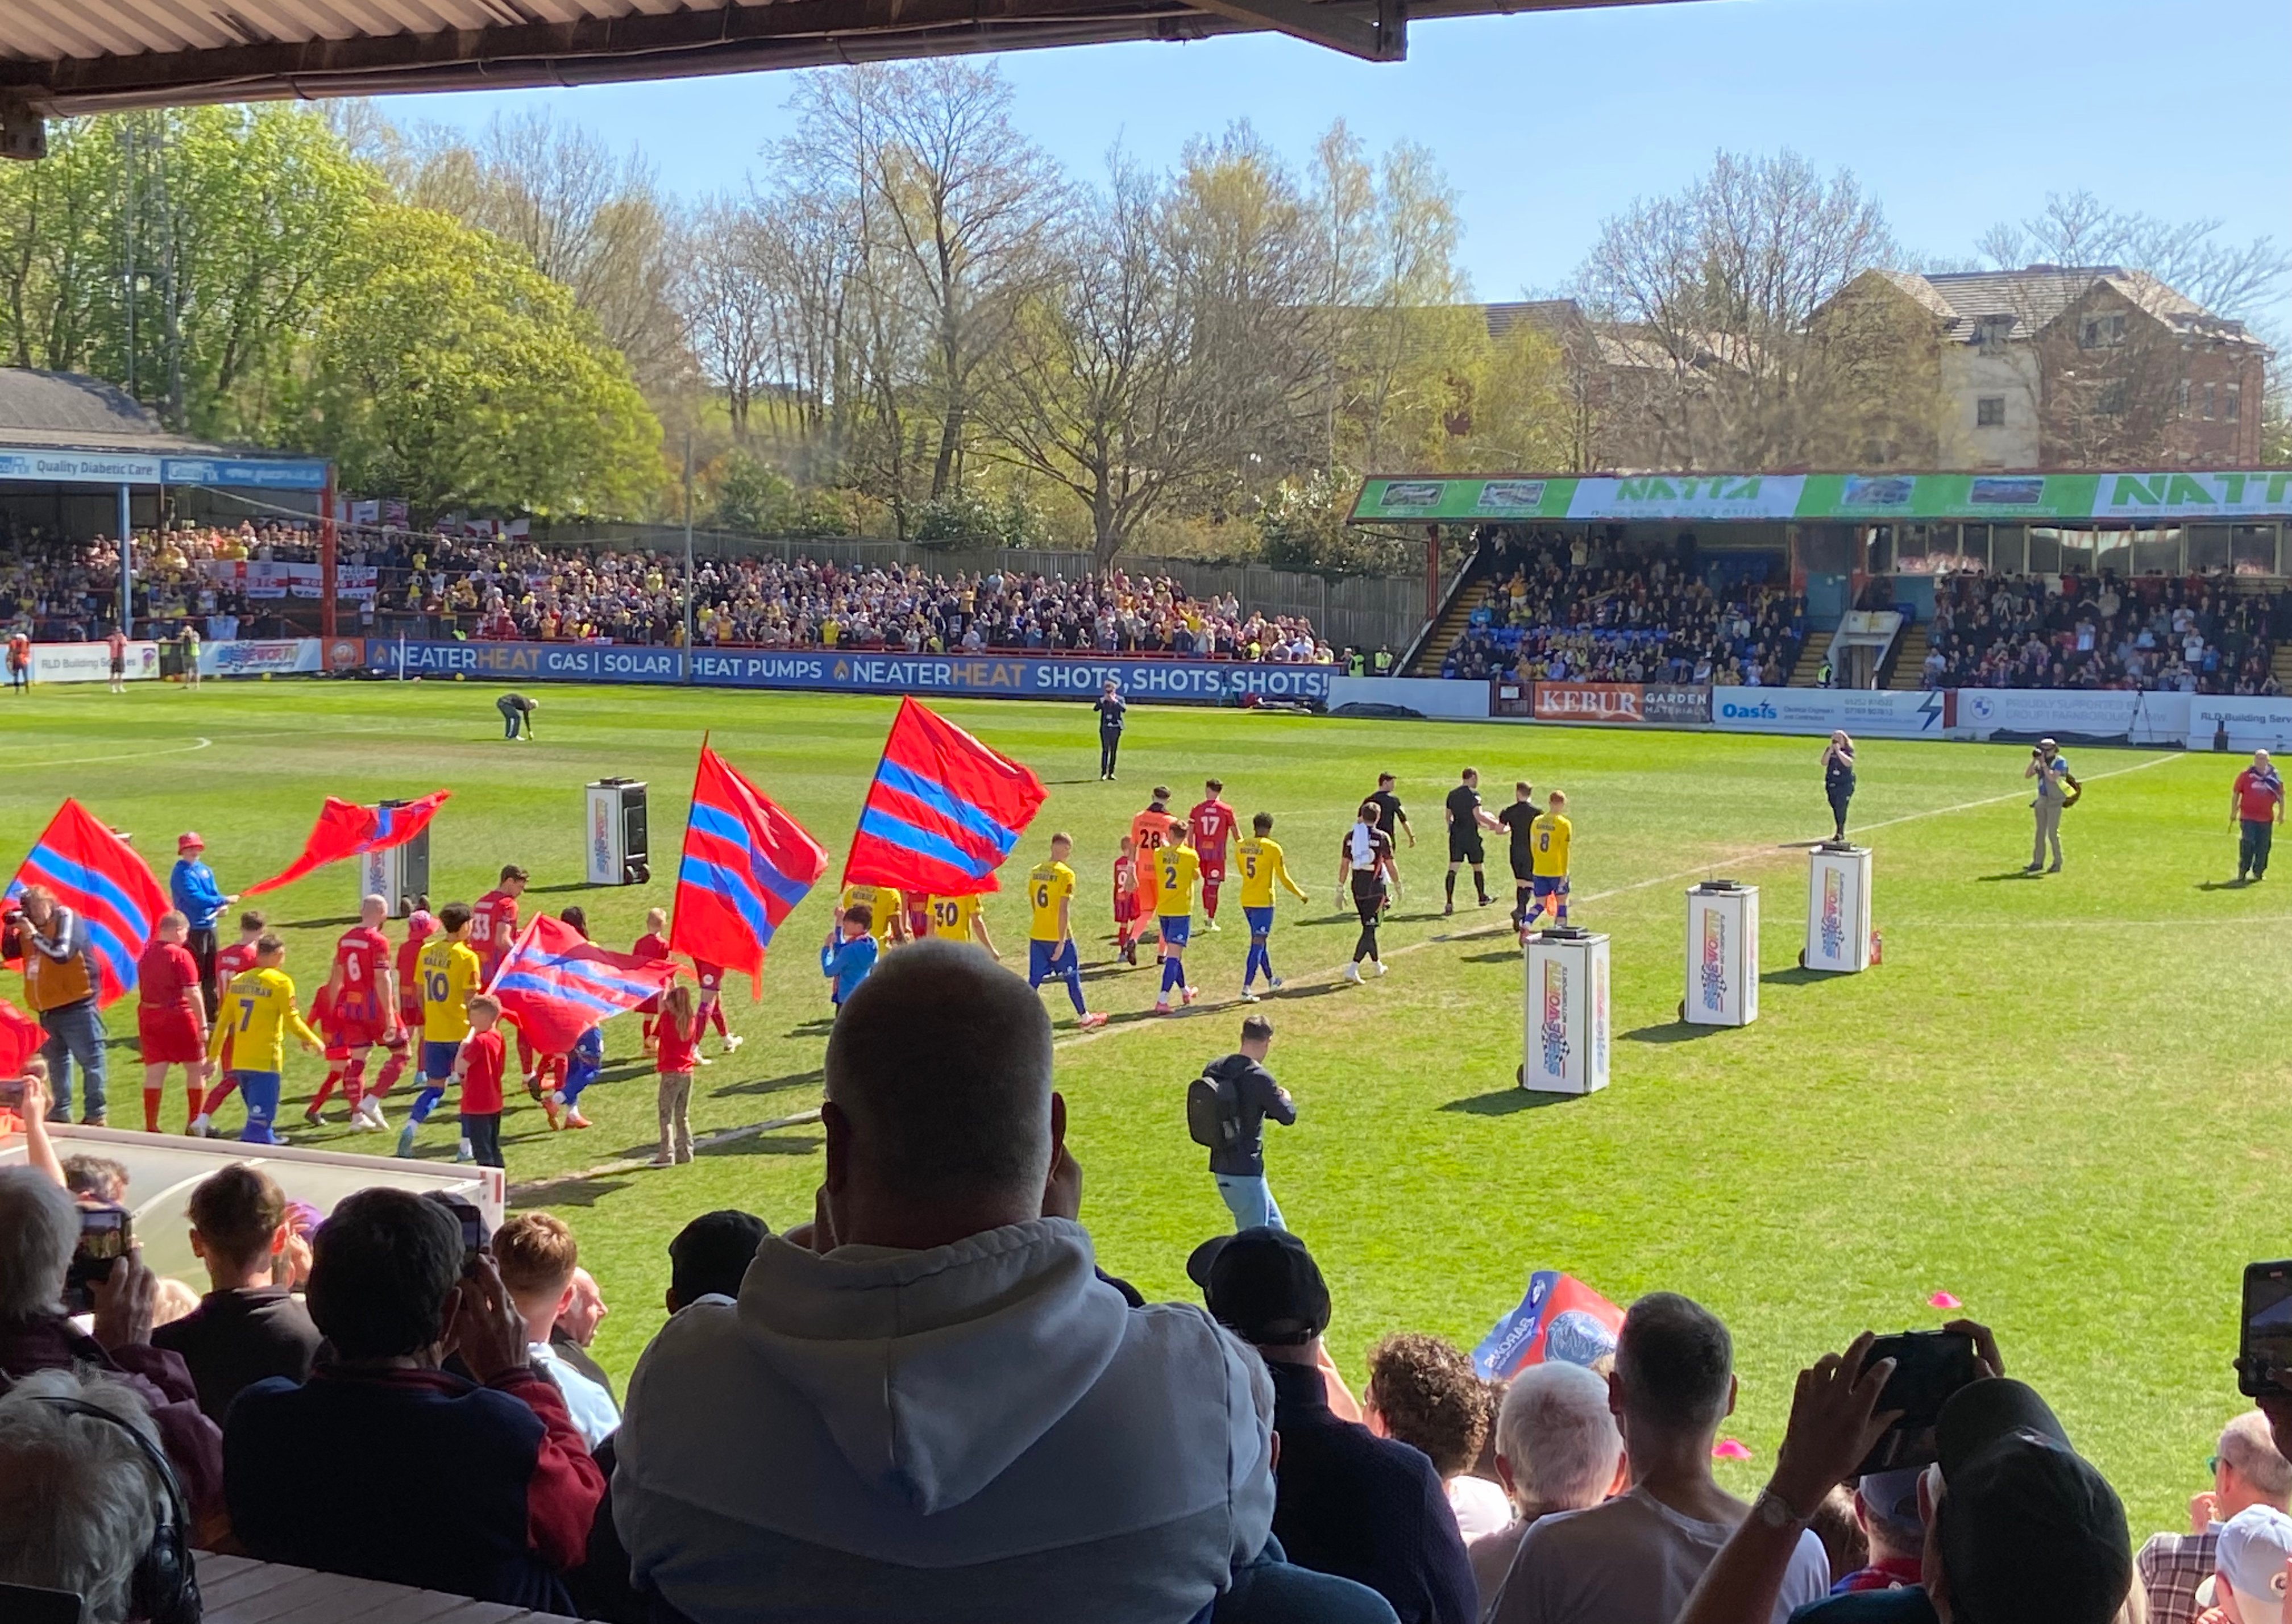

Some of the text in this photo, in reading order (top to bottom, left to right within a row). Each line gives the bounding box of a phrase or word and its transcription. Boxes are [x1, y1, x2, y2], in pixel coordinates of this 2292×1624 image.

[38, 460, 78, 476] Quality
[81, 461, 126, 475] Diabetic
[128, 464, 153, 476] Care
[1617, 476, 1763, 501] NATTA
[41, 657, 136, 670] RLD Building Sees
[549, 651, 589, 671] GAS
[604, 654, 671, 674] SOLAR
[690, 658, 743, 676] HEAT
[748, 658, 823, 679] PUMPS
[854, 661, 1026, 688] NEATERHEAT
[1541, 689, 1637, 713] KEBUR
[1645, 692, 1707, 705] GARDEN
[1722, 699, 1778, 720] Oasis
[2006, 698, 2053, 709] PROUDLY
[2056, 699, 2124, 710] SUPPORTED
[2005, 709, 2044, 720] GROUP
[2200, 712, 2220, 721] RLD
[2225, 713, 2266, 724] Building
[1200, 816, 1220, 836] 17
[1140, 828, 1161, 850] 28
[1539, 833, 1550, 853] 8
[1165, 866, 1178, 889] 2
[1246, 855, 1256, 880] 5
[1037, 884, 1049, 908] 6
[934, 902, 959, 927] 30
[347, 952, 362, 982] 6
[423, 969, 450, 1002] 10
[239, 997, 255, 1032] 7
